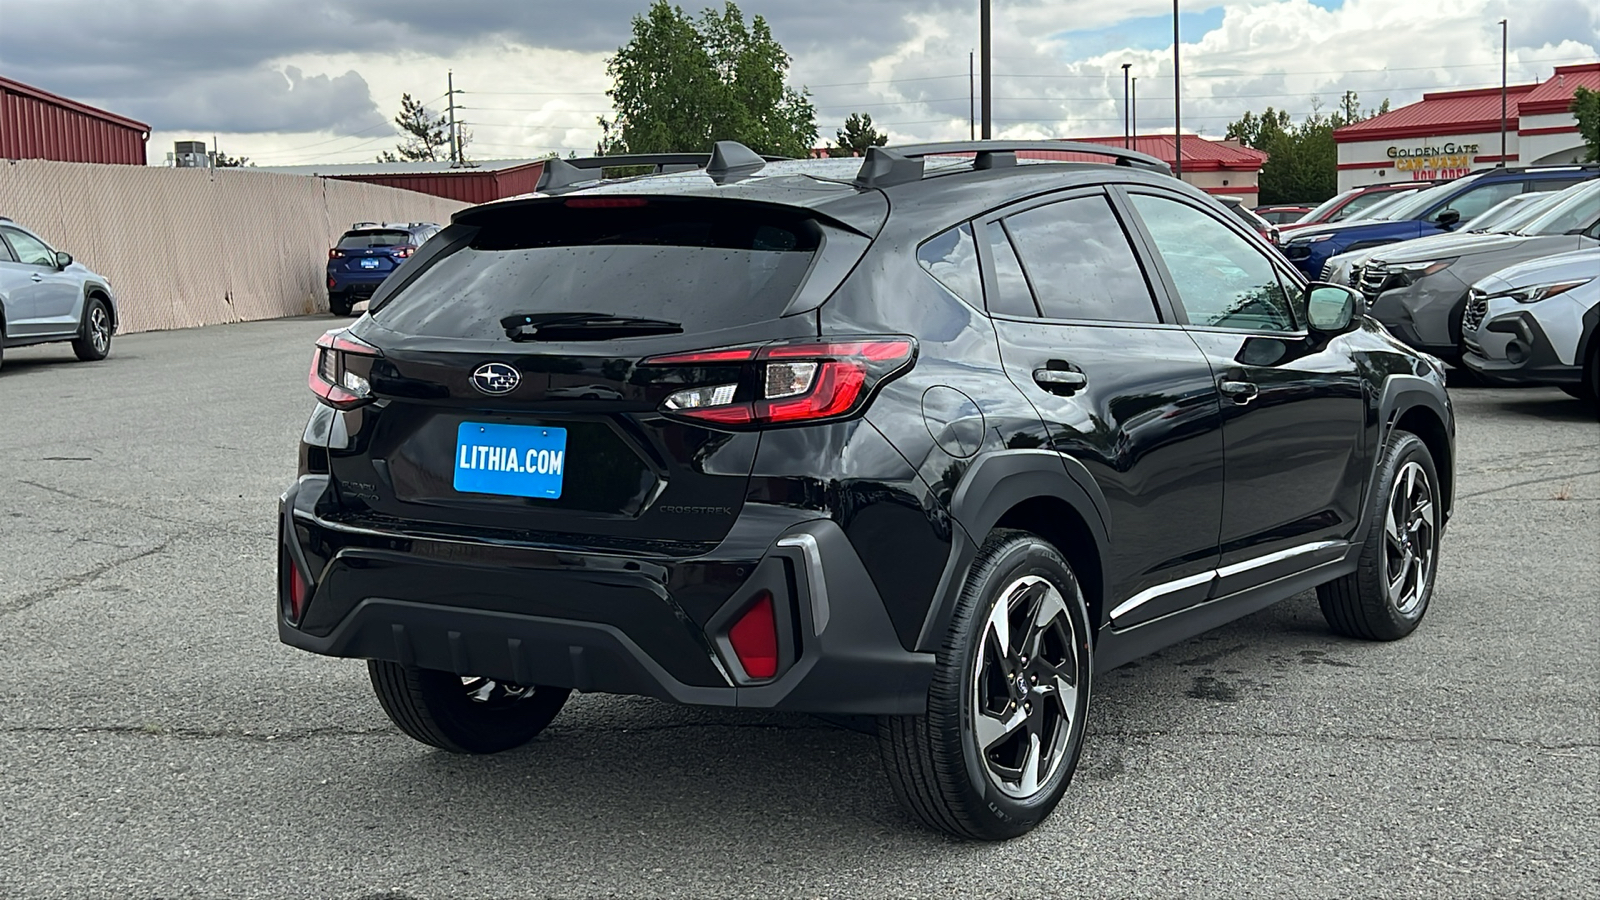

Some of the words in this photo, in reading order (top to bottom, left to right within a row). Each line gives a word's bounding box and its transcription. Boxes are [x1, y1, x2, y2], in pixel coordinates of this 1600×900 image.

[1387, 147, 1440, 158] GOLDEN
[1443, 143, 1479, 155] GATE
[1396, 156, 1425, 171] CAR
[1428, 155, 1469, 169] WASH
[1413, 169, 1437, 181] NOW
[460, 444, 562, 476] LITHIA.COM
[342, 480, 377, 492] SUBARU
[659, 505, 732, 515] CROSSTREK
